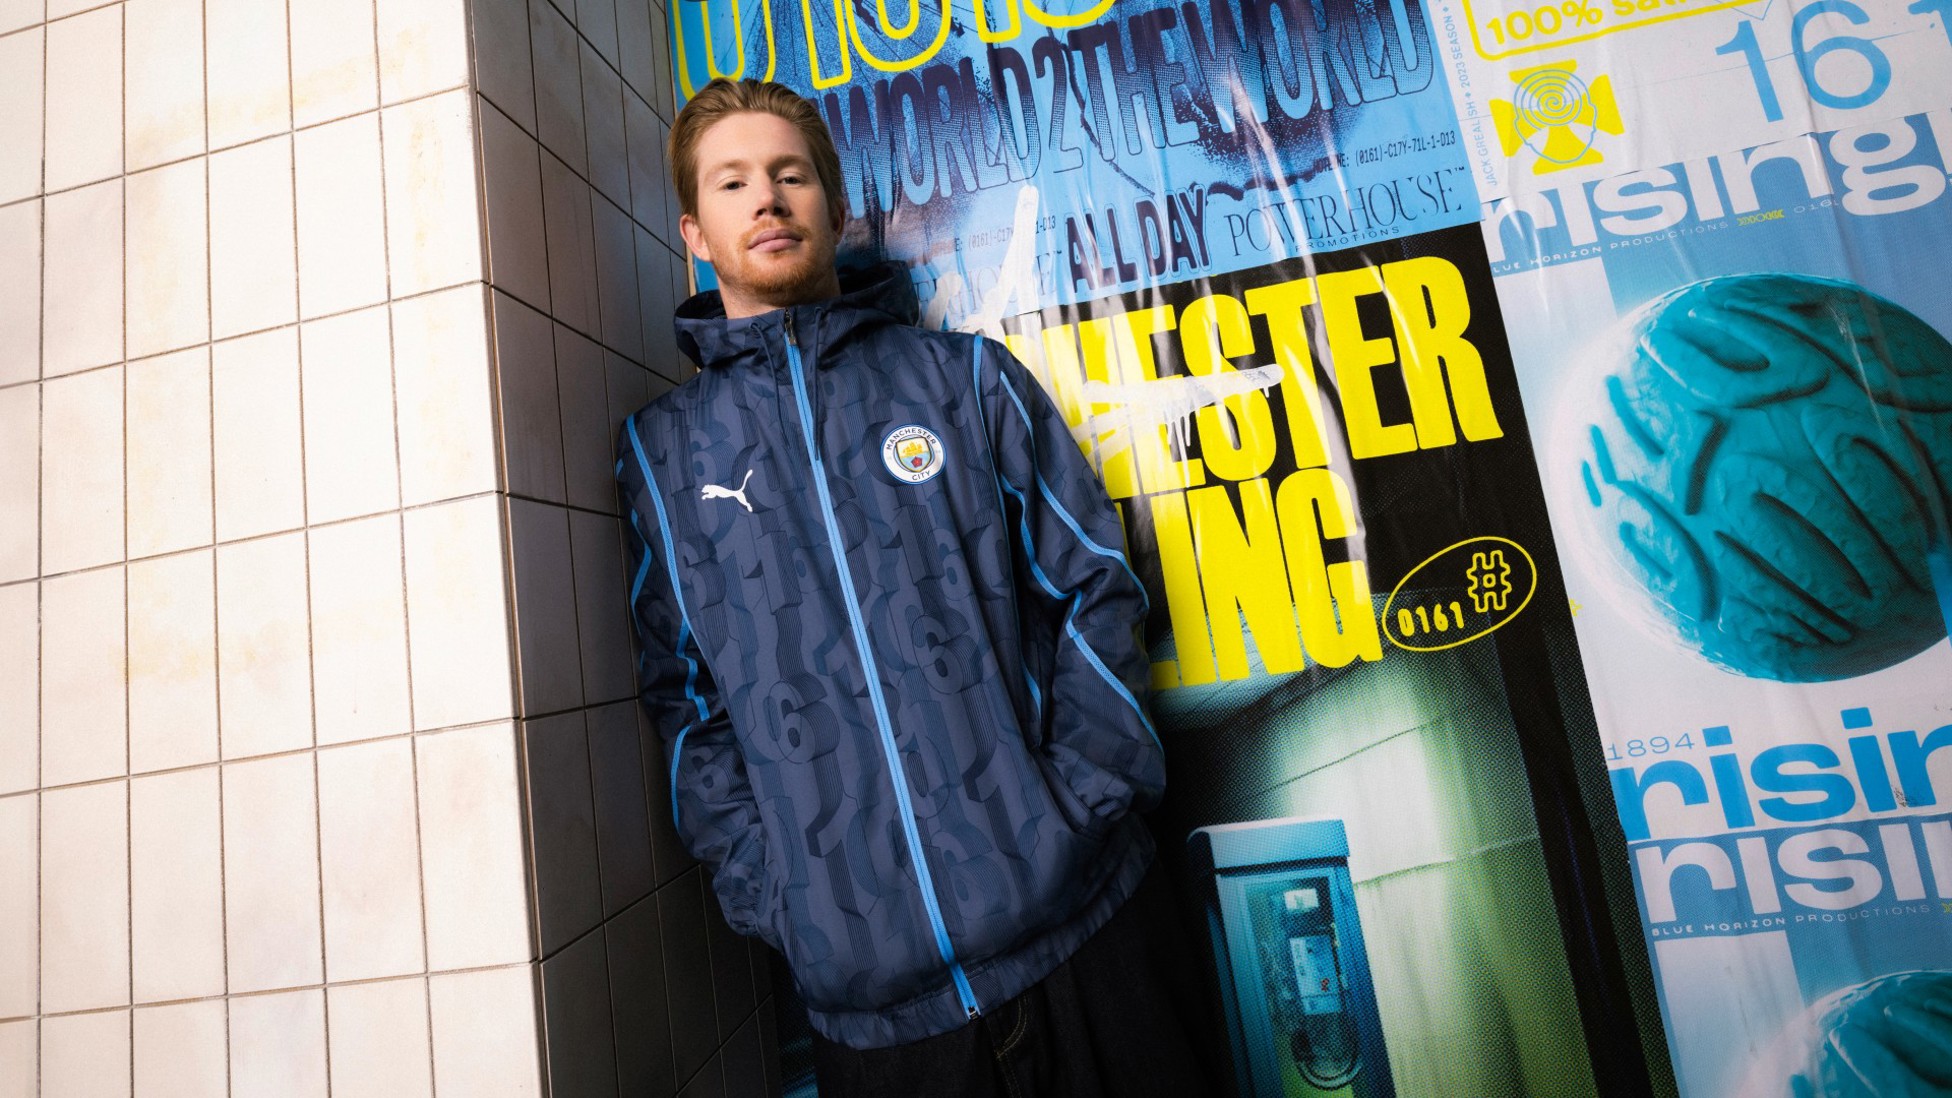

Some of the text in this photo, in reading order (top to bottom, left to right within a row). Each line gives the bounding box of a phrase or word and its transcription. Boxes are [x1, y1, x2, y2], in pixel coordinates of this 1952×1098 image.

[1486, 0, 1603, 45] 100%
[1443, 15, 1498, 186] JACK GREALISH 2023 SEASON
[1066, 205, 1138, 293] ALL
[1135, 188, 1210, 278] DAY
[1295, 225, 1401, 252] PROMOTIONS
[1493, 221, 1730, 275] LUE HORIZON PRODUCTIONS
[1004, 256, 1504, 500] HESTER
[886, 427, 937, 450] MANCHESTER
[911, 470, 931, 481] CITY
[1112, 469, 1384, 691] ING
[1398, 601, 1465, 637] 0161
[1607, 733, 1695, 761] 1894
[1652, 924, 1694, 938] BLUE
[1704, 917, 1786, 932] HORIZON
[1796, 904, 1931, 923] PRODUCTIONS
